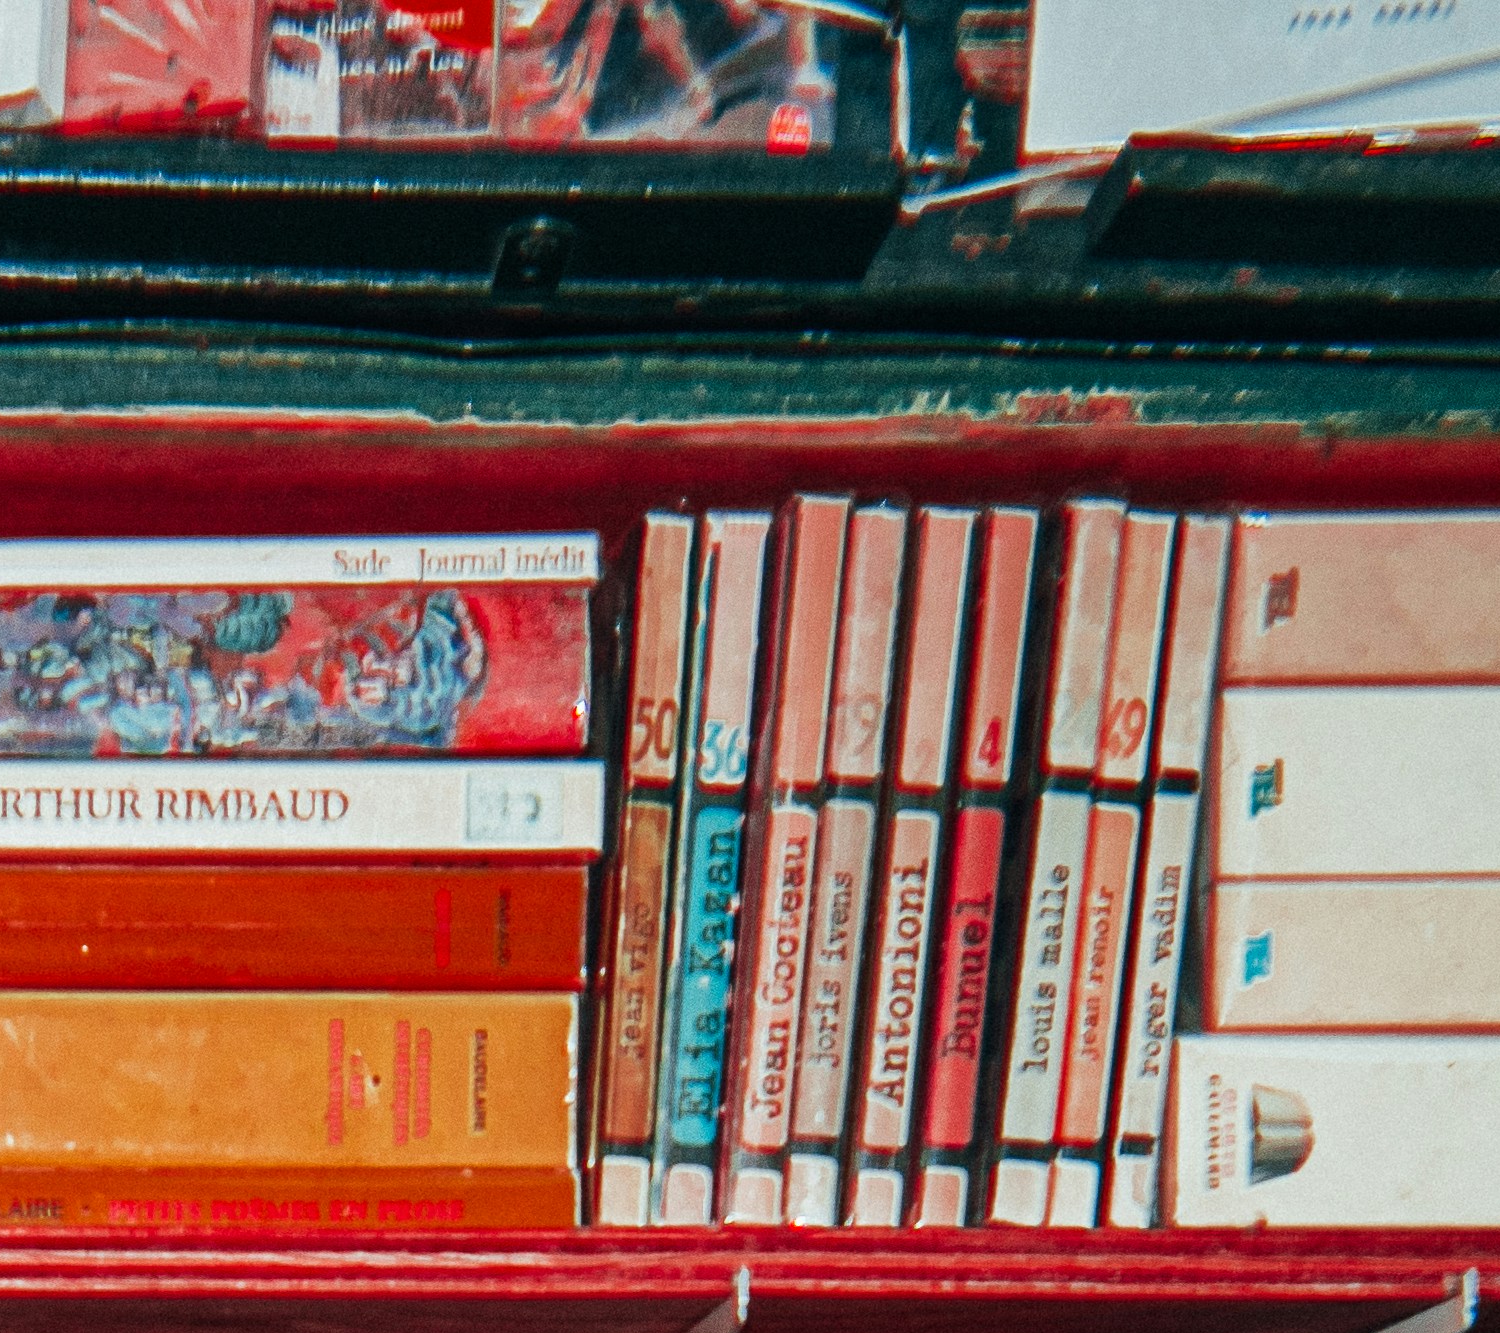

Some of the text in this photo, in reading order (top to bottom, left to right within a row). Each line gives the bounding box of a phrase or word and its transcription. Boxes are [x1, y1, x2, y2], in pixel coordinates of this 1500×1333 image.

[333, 545, 588, 582] Sade Journal inédit
[631, 699, 678, 761] 50
[699, 718, 750, 779] 36
[154, 783, 352, 825] RIMBAUD
[818, 871, 854, 964] ivens
[678, 828, 736, 1122] Elia Kazan
[867, 857, 930, 1109] Antonioni
[1019, 863, 1072, 1075] louis malle
[1134, 863, 1183, 1080] roger vadim
[749, 1018, 793, 1120] Jean
